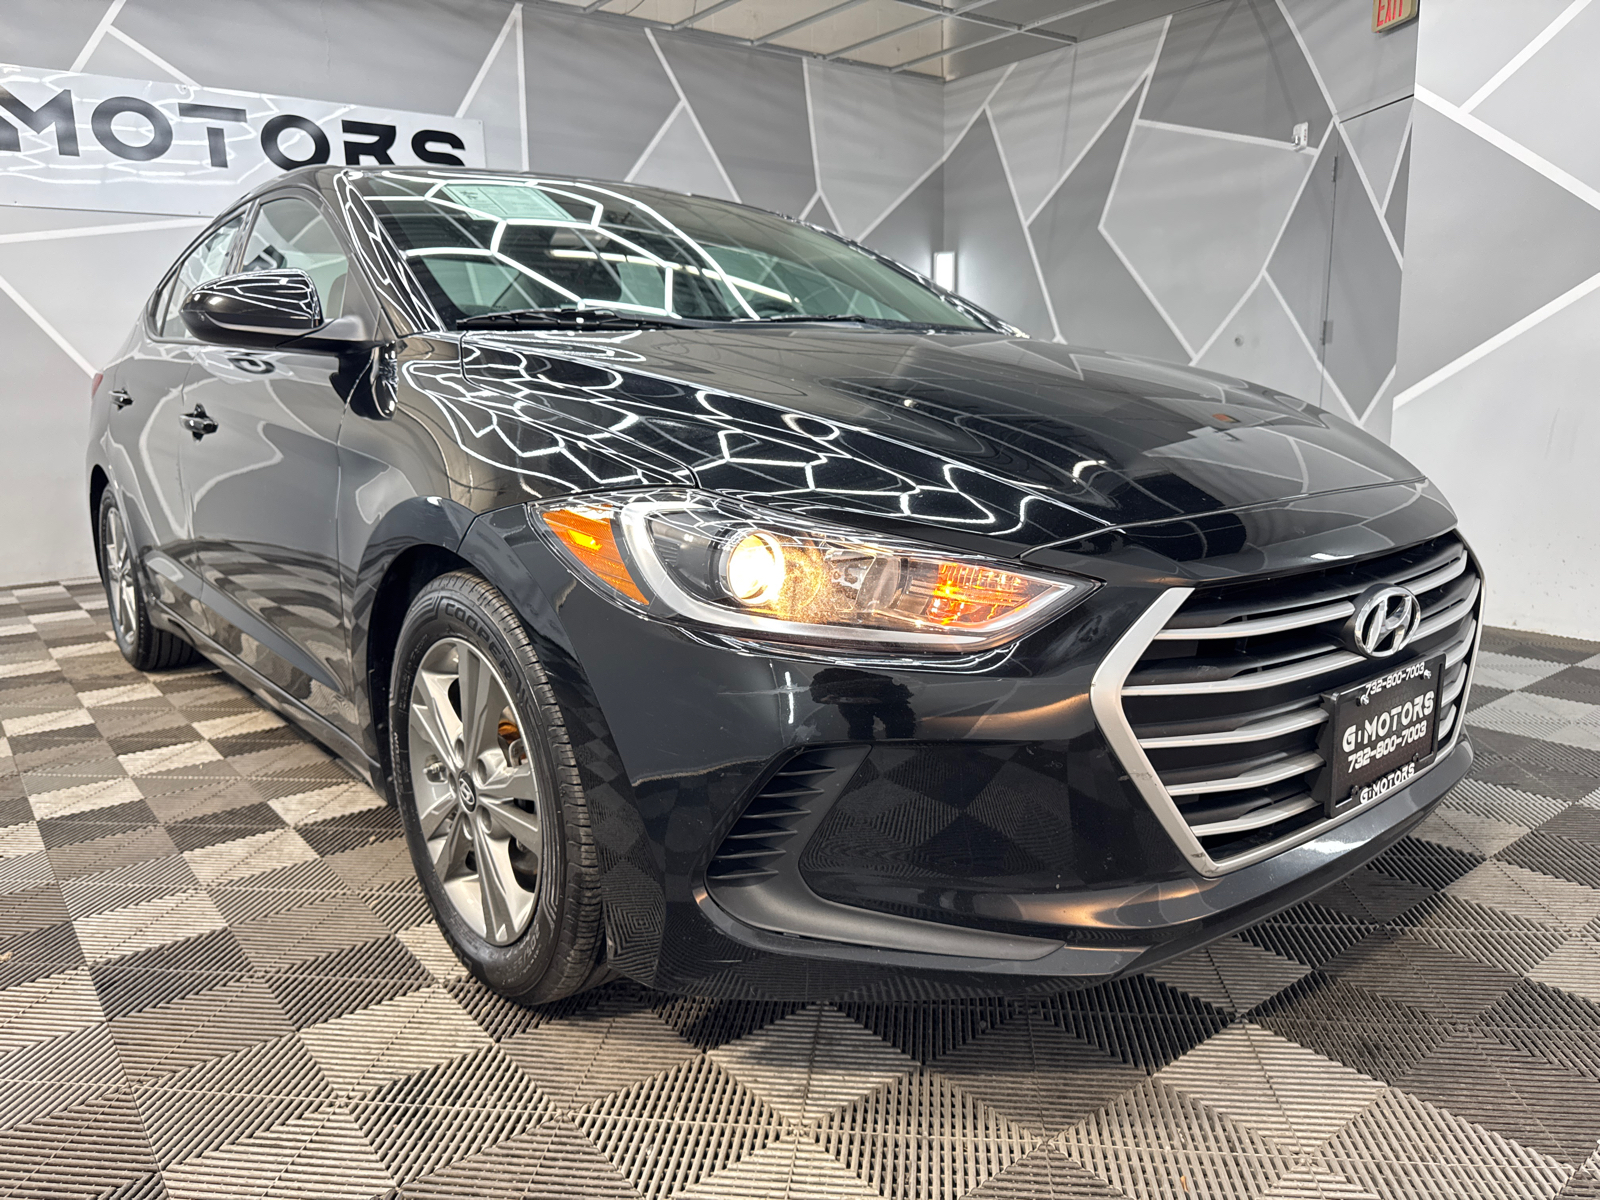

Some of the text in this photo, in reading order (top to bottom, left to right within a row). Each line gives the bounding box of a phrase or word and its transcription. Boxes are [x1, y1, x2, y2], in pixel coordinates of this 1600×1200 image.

[0, 84, 466, 169] MOTORS
[445, 603, 512, 681] COOPER
[1365, 661, 1425, 698] 732-800-7003
[1347, 720, 1427, 773] 732-800-7003
